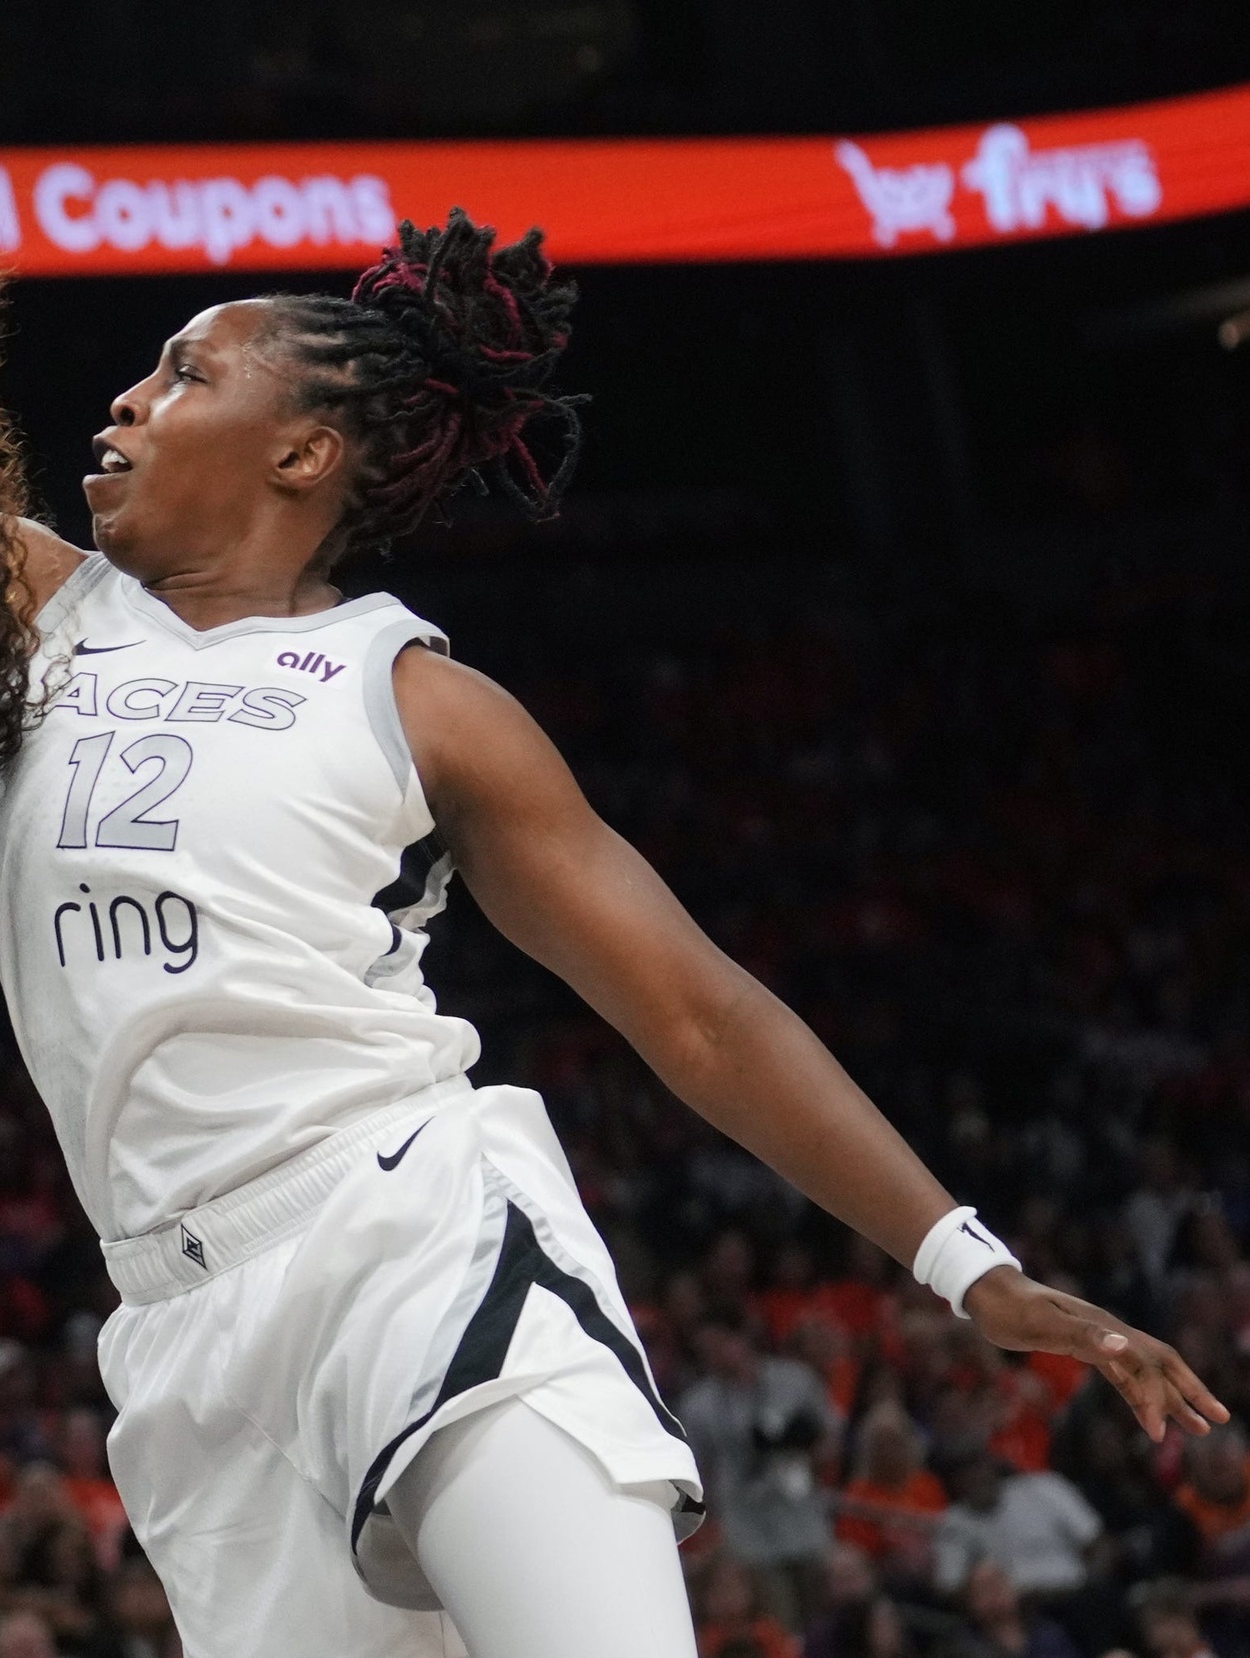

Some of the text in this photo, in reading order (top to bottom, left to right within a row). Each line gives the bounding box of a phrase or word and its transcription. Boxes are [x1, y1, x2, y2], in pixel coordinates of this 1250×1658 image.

[34, 162, 397, 266] Coupons
[34, 672, 307, 731] ACES
[276, 651, 347, 683] ally
[56, 731, 193, 851] 12
[54, 883, 198, 974] ring
